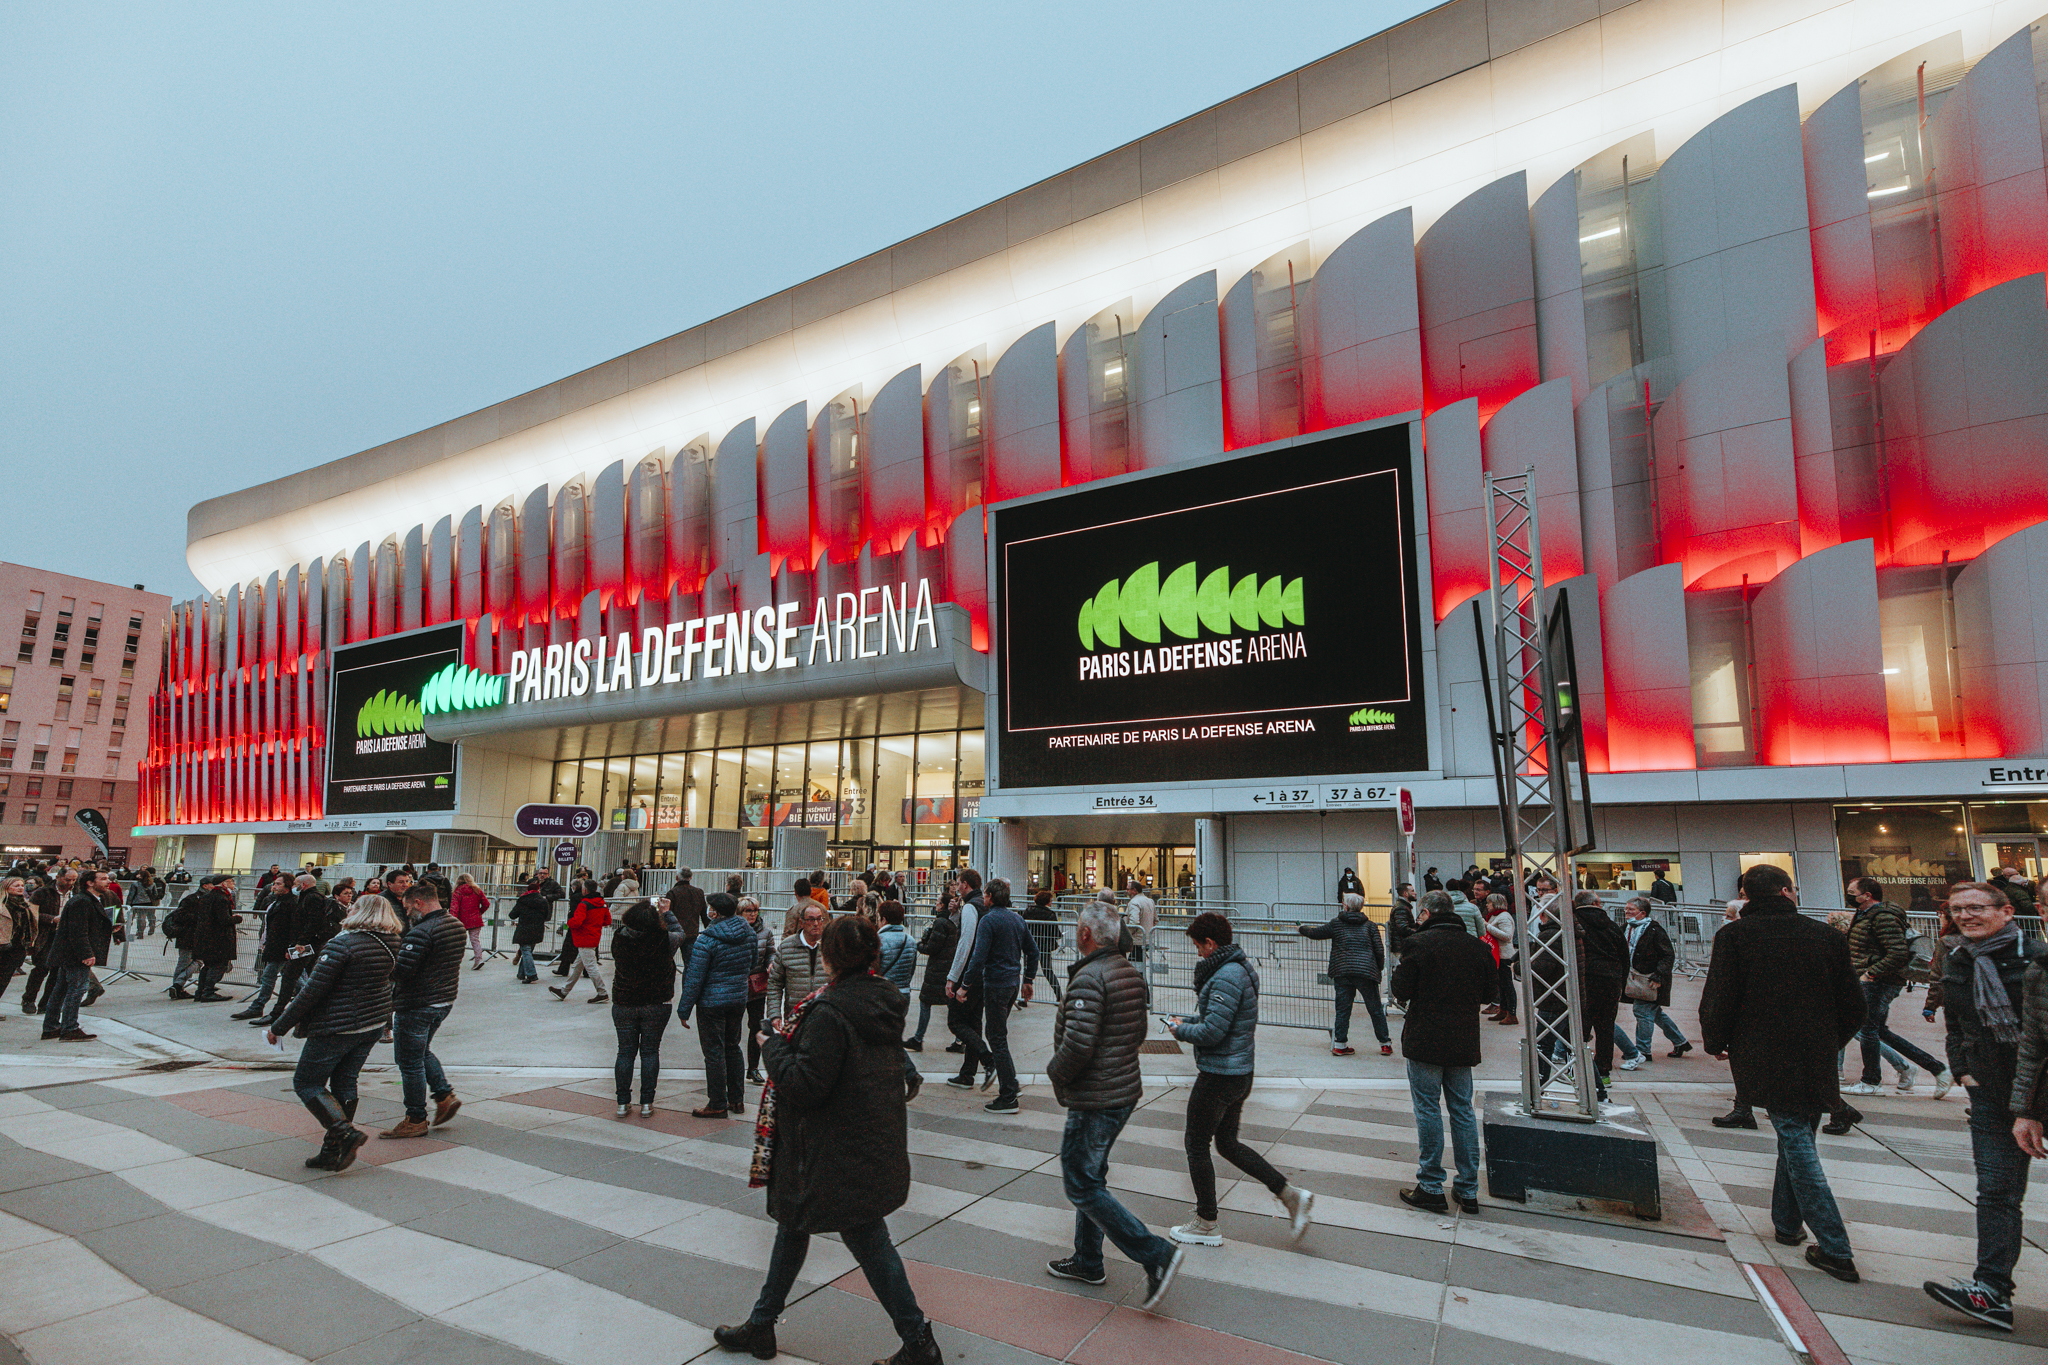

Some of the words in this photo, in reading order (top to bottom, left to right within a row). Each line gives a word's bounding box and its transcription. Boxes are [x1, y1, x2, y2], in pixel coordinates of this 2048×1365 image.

[508, 637, 592, 705] PARIS
[595, 632, 634, 694] LA
[640, 601, 800, 688] DEFENSE
[808, 577, 939, 666] ARENA
[1079, 652, 1131, 681] PARIS
[1133, 649, 1156, 675] LA
[1159, 638, 1243, 673] DEFENSE
[1247, 631, 1308, 664] ARENA
[1049, 732, 1120, 748] PARTENAIRE
[1123, 731, 1140, 744] DE
[1143, 728, 1179, 742] PARIS
[1182, 727, 1199, 740] LA
[1201, 722, 1263, 738] DEFENSE
[1266, 719, 1316, 734] ARENA
[355, 739, 374, 755] PARIS
[374, 738, 381, 752] LA
[381, 735, 408, 752] DEFENSE
[408, 733, 427, 749] ARENA
[1989, 767, 2048, 782] Entr
[343, 784, 367, 793] PARTENAIRE
[367, 784, 373, 792] DE
[373, 783, 385, 791] PARIS
[385, 783, 391, 791] LA
[391, 781, 411, 790] DEFENSE
[410, 781, 426, 789] ARENA
[844, 787, 868, 795] Entrée
[1331, 789, 1348, 800] 37
[1354, 788, 1362, 799] à
[1367, 788, 1386, 799] 67
[1096, 795, 1134, 806] Entrée
[1138, 795, 1153, 805] 34
[1269, 791, 1274, 802] 1
[1279, 790, 1287, 801] à
[1292, 790, 1309, 801] 37
[660, 804, 677, 819] 33
[747, 803, 764, 817] 33
[844, 798, 866, 815] 33
[533, 816, 564, 826] ENTRÉE
[574, 816, 590, 828] 33
[1888, 876, 1896, 884] LA
[1897, 877, 1926, 885] DEFENSE
[1927, 877, 1947, 885] ARENA
[1968, 1293, 1989, 1309] N
